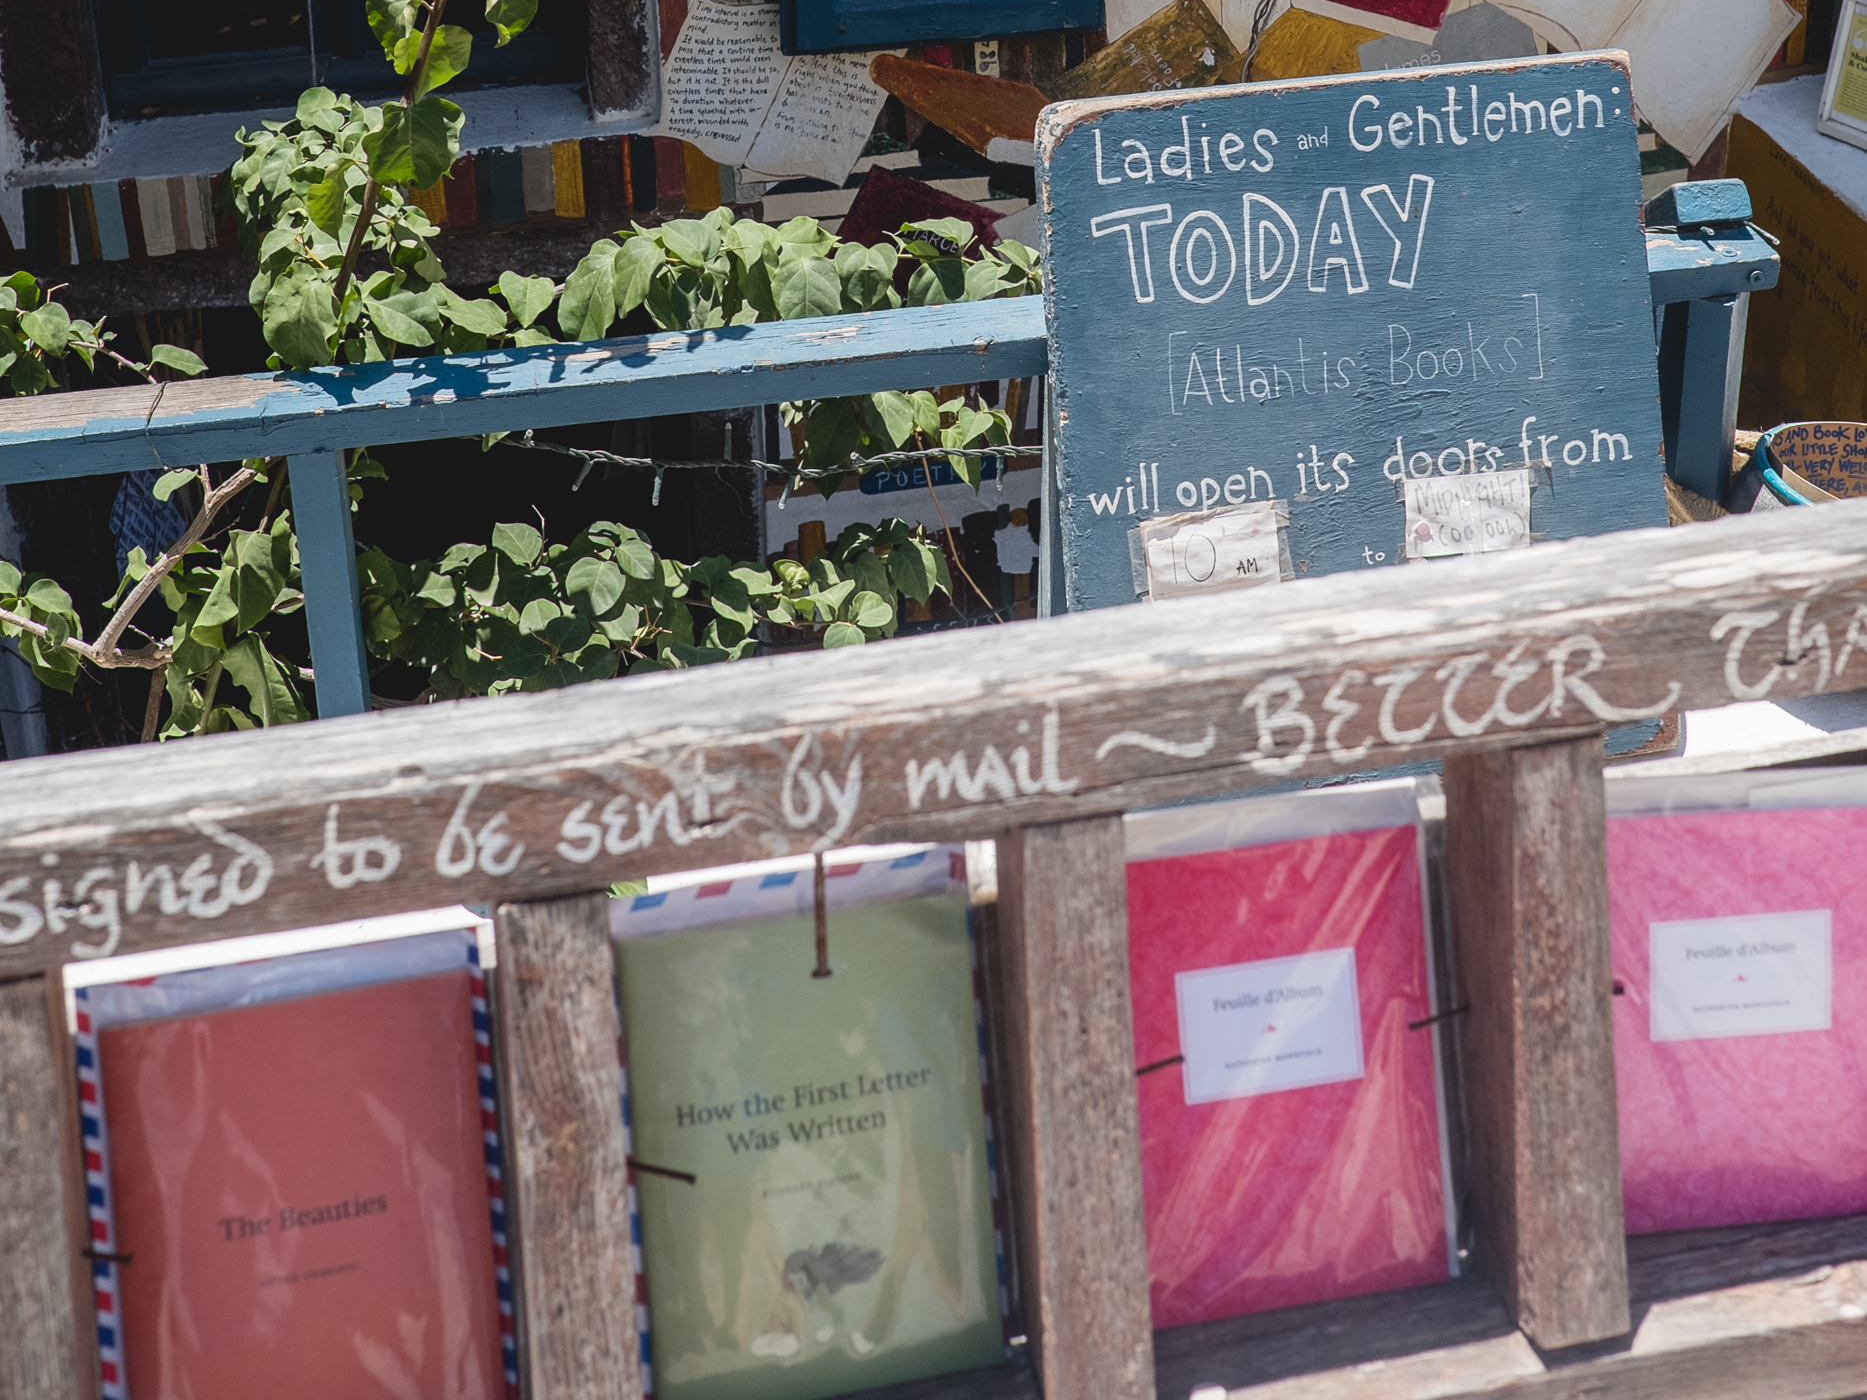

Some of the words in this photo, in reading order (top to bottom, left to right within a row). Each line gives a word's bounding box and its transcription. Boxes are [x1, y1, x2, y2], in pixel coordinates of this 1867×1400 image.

[695, 1, 712, 14] Time
[742, 19, 767, 28] matter
[716, 36, 726, 46] be
[726, 34, 768, 46] reasonable
[697, 46, 716, 56] that
[726, 46, 755, 55] routine
[757, 45, 774, 53] time
[707, 56, 727, 65] time
[721, 66, 732, 75] It
[732, 65, 757, 75] should
[667, 76, 682, 85] but
[740, 76, 754, 85] the
[728, 87, 748, 95] that
[749, 87, 769, 95] have
[682, 97, 715, 106] duration
[729, 107, 747, 116] with
[1093, 115, 1280, 186] Ladies
[1297, 126, 1330, 152] and
[1347, 85, 1623, 153] Gentlemen:
[1089, 173, 1436, 306] TODAY
[1784, 426, 1810, 444] AND
[1813, 424, 1851, 442] BOOK
[1778, 443, 1798, 458] OUR
[1801, 442, 1839, 457] LITTLE
[1088, 461, 1160, 516] will
[1176, 464, 1275, 512] open
[1295, 443, 1357, 496] its
[1382, 435, 1505, 486] doors
[1516, 415, 1634, 471] from
[1803, 457, 1836, 475] VERY
[1171, 533, 1219, 584] 10
[1235, 555, 1260, 576] AM
[1361, 546, 1386, 565] to
[0, 807, 274, 961] signed
[310, 802, 401, 890] to
[435, 775, 526, 879] be
[781, 732, 863, 852] by
[676, 1097, 736, 1130] How
[742, 1088, 786, 1118] the
[793, 1080, 849, 1111] First
[856, 1065, 932, 1098] Letter
[726, 1126, 781, 1156] Was
[787, 1106, 888, 1148] Written
[216, 1214, 271, 1243] The
[278, 1192, 389, 1233] Beauties
